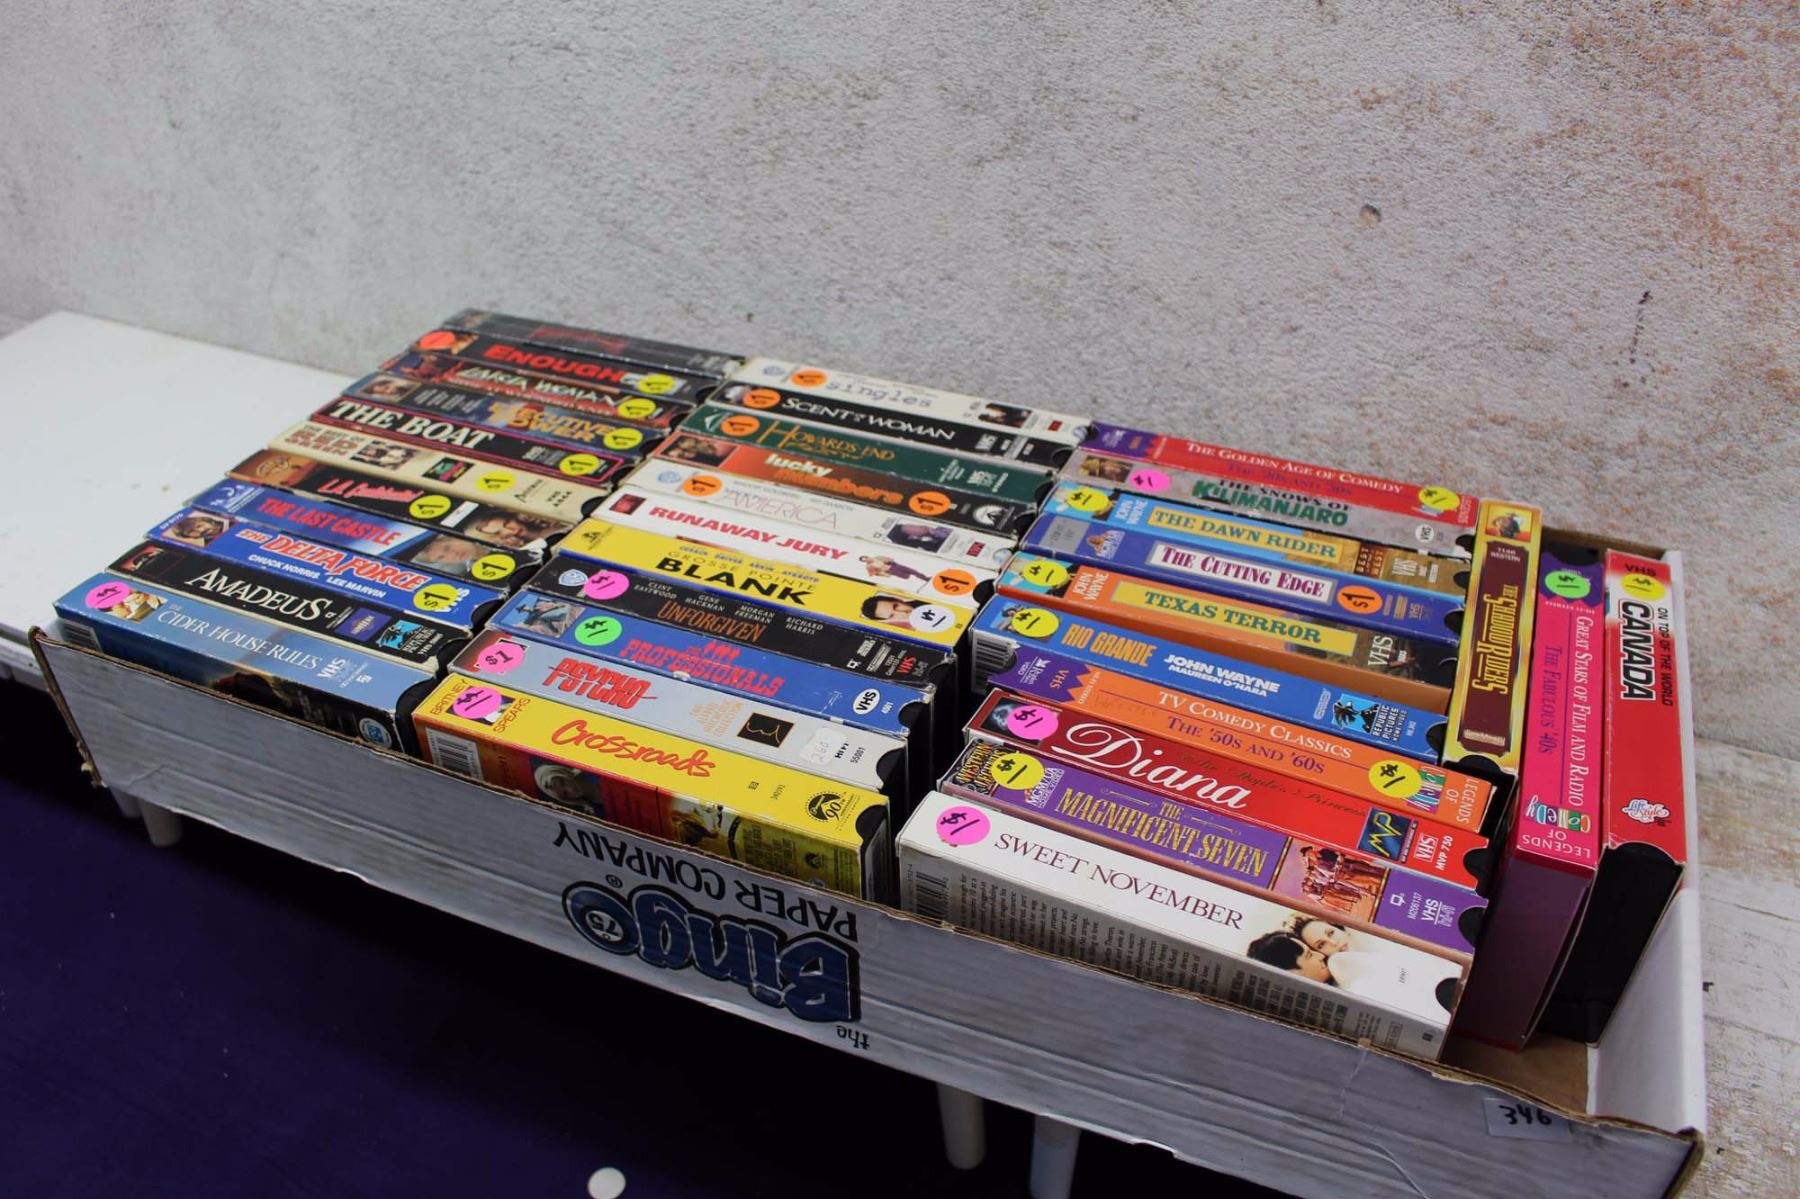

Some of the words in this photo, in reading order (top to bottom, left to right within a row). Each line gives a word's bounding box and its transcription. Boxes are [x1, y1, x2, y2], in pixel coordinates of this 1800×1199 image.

[484, 344, 625, 382] ENOUGH
[825, 380, 931, 408] singles
[330, 400, 403, 428] THE
[396, 416, 495, 450] BOAT
[782, 397, 854, 420] SCENT
[868, 414, 956, 440] WOMAN
[756, 420, 859, 455] HOWARDS
[764, 453, 833, 478] lucky
[1187, 442, 1216, 457] THE
[1219, 448, 1279, 469] GOLDEN
[1281, 463, 1314, 476] AGE
[1316, 470, 1337, 480] OF
[1339, 472, 1404, 494] COMEDY
[1192, 479, 1349, 527] KILIMANJARO
[1219, 478, 1253, 491] THE
[1260, 486, 1324, 506] SNOWS
[258, 497, 295, 517] THE
[289, 502, 333, 528] LAST
[330, 516, 401, 546] CASTLE
[649, 506, 779, 544] RUNAWAY
[776, 537, 849, 560] JURY
[1155, 510, 1197, 529] THE
[1201, 517, 1262, 542] DAWN
[1266, 533, 1337, 558] RIDER
[235, 528, 272, 544] THE
[259, 534, 346, 574] DELTA
[328, 555, 432, 592] FORCE
[248, 554, 282, 570] CHUCK
[282, 562, 320, 579] NORRIS
[327, 576, 345, 588] LEE
[344, 581, 387, 598] MARVIN
[667, 551, 736, 572] GROSSE
[748, 571, 817, 590] POINTE
[1163, 546, 1198, 568] THE
[1200, 553, 1273, 586] CUTTING
[1276, 572, 1325, 598] EDGE
[1625, 563, 1656, 577] VHS
[184, 567, 334, 621] AMADEUS
[634, 584, 678, 599] EASTWOOD
[648, 581, 673, 592] CLINT
[656, 557, 812, 605] BLANK
[1072, 572, 1095, 594] JOHN
[1084, 572, 1109, 600] WAYNE
[1502, 584, 1519, 598] THE
[685, 597, 725, 612] HACKMAN
[698, 594, 721, 604] GENE
[734, 609, 772, 624] FREEMAN
[740, 605, 776, 618] MORGAN
[1145, 590, 1218, 619] TEXAS
[1224, 609, 1322, 643] TERROR
[1658, 607, 1668, 620] ON
[657, 600, 768, 643] UNFORGIVEN
[785, 623, 816, 636] HARRIS
[786, 616, 824, 631] RICHARD
[1576, 614, 1595, 650] GREAT
[1658, 622, 1669, 638] TOP
[157, 610, 206, 635] CIDER
[208, 624, 270, 653] HOUSE
[267, 642, 323, 670] RULES
[1061, 624, 1095, 649] RIO
[1090, 631, 1158, 667] GRANDE
[1367, 635, 1394, 667] VHS
[1545, 645, 1563, 663] THE
[1619, 598, 1657, 701] CANADA
[1661, 639, 1671, 651] OF
[316, 657, 346, 679] VHS
[485, 650, 513, 666] $1
[619, 638, 786, 697] PROFESSIONALS
[896, 655, 917, 674] VHS
[1163, 653, 1215, 674] JOHN
[1216, 666, 1280, 693] WAYNE
[1574, 651, 1593, 686] STARS
[1662, 653, 1672, 672] THE
[1049, 668, 1070, 689] VHS
[1168, 664, 1224, 685] MAUREEN
[1222, 678, 1268, 697] O'HARA
[1541, 664, 1562, 728] FABULOUS
[1661, 674, 1673, 706] WORLD
[430, 678, 467, 715] BRITNEY
[855, 690, 878, 713] VHS
[493, 696, 530, 733] SPEARS
[1159, 691, 1188, 708] TV
[1188, 702, 1267, 734] COMEDY
[1270, 724, 1353, 759] CLASSICS
[1372, 704, 1390, 737] REPUBLIC
[1382, 708, 1399, 740] PICTURES
[1571, 701, 1592, 734] FILM
[550, 719, 717, 778] Crossroads
[1168, 715, 1202, 738] THE
[1247, 744, 1284, 763] AND
[1570, 735, 1586, 765] AND
[957, 742, 994, 783] WESTERN
[1051, 723, 1252, 810] Diana
[1027, 767, 1058, 805] MGM/UA
[1446, 789, 1459, 803] OF
[1456, 778, 1480, 824] LEGENDS
[1568, 763, 1590, 806] RADIO
[1159, 800, 1185, 820] THE
[1054, 786, 1199, 853] MAGNIFICENT
[1198, 832, 1269, 877] SEVEN
[1415, 835, 1437, 861] VHS
[1522, 833, 1591, 859] LEGENDS
[1548, 829, 1567, 841] OF
[553, 822, 726, 900] COMPANY
[1435, 850, 1448, 871] MVP
[1442, 834, 1454, 852] 750
[994, 832, 1089, 875] SWEET
[1091, 863, 1244, 930] NOVEMBER
[734, 879, 859, 943] PAPER
[1421, 898, 1440, 923] VHS
[562, 879, 862, 1023] Bingo
[836, 1024, 871, 1050] the
[1497, 1104, 1554, 1126] 346
